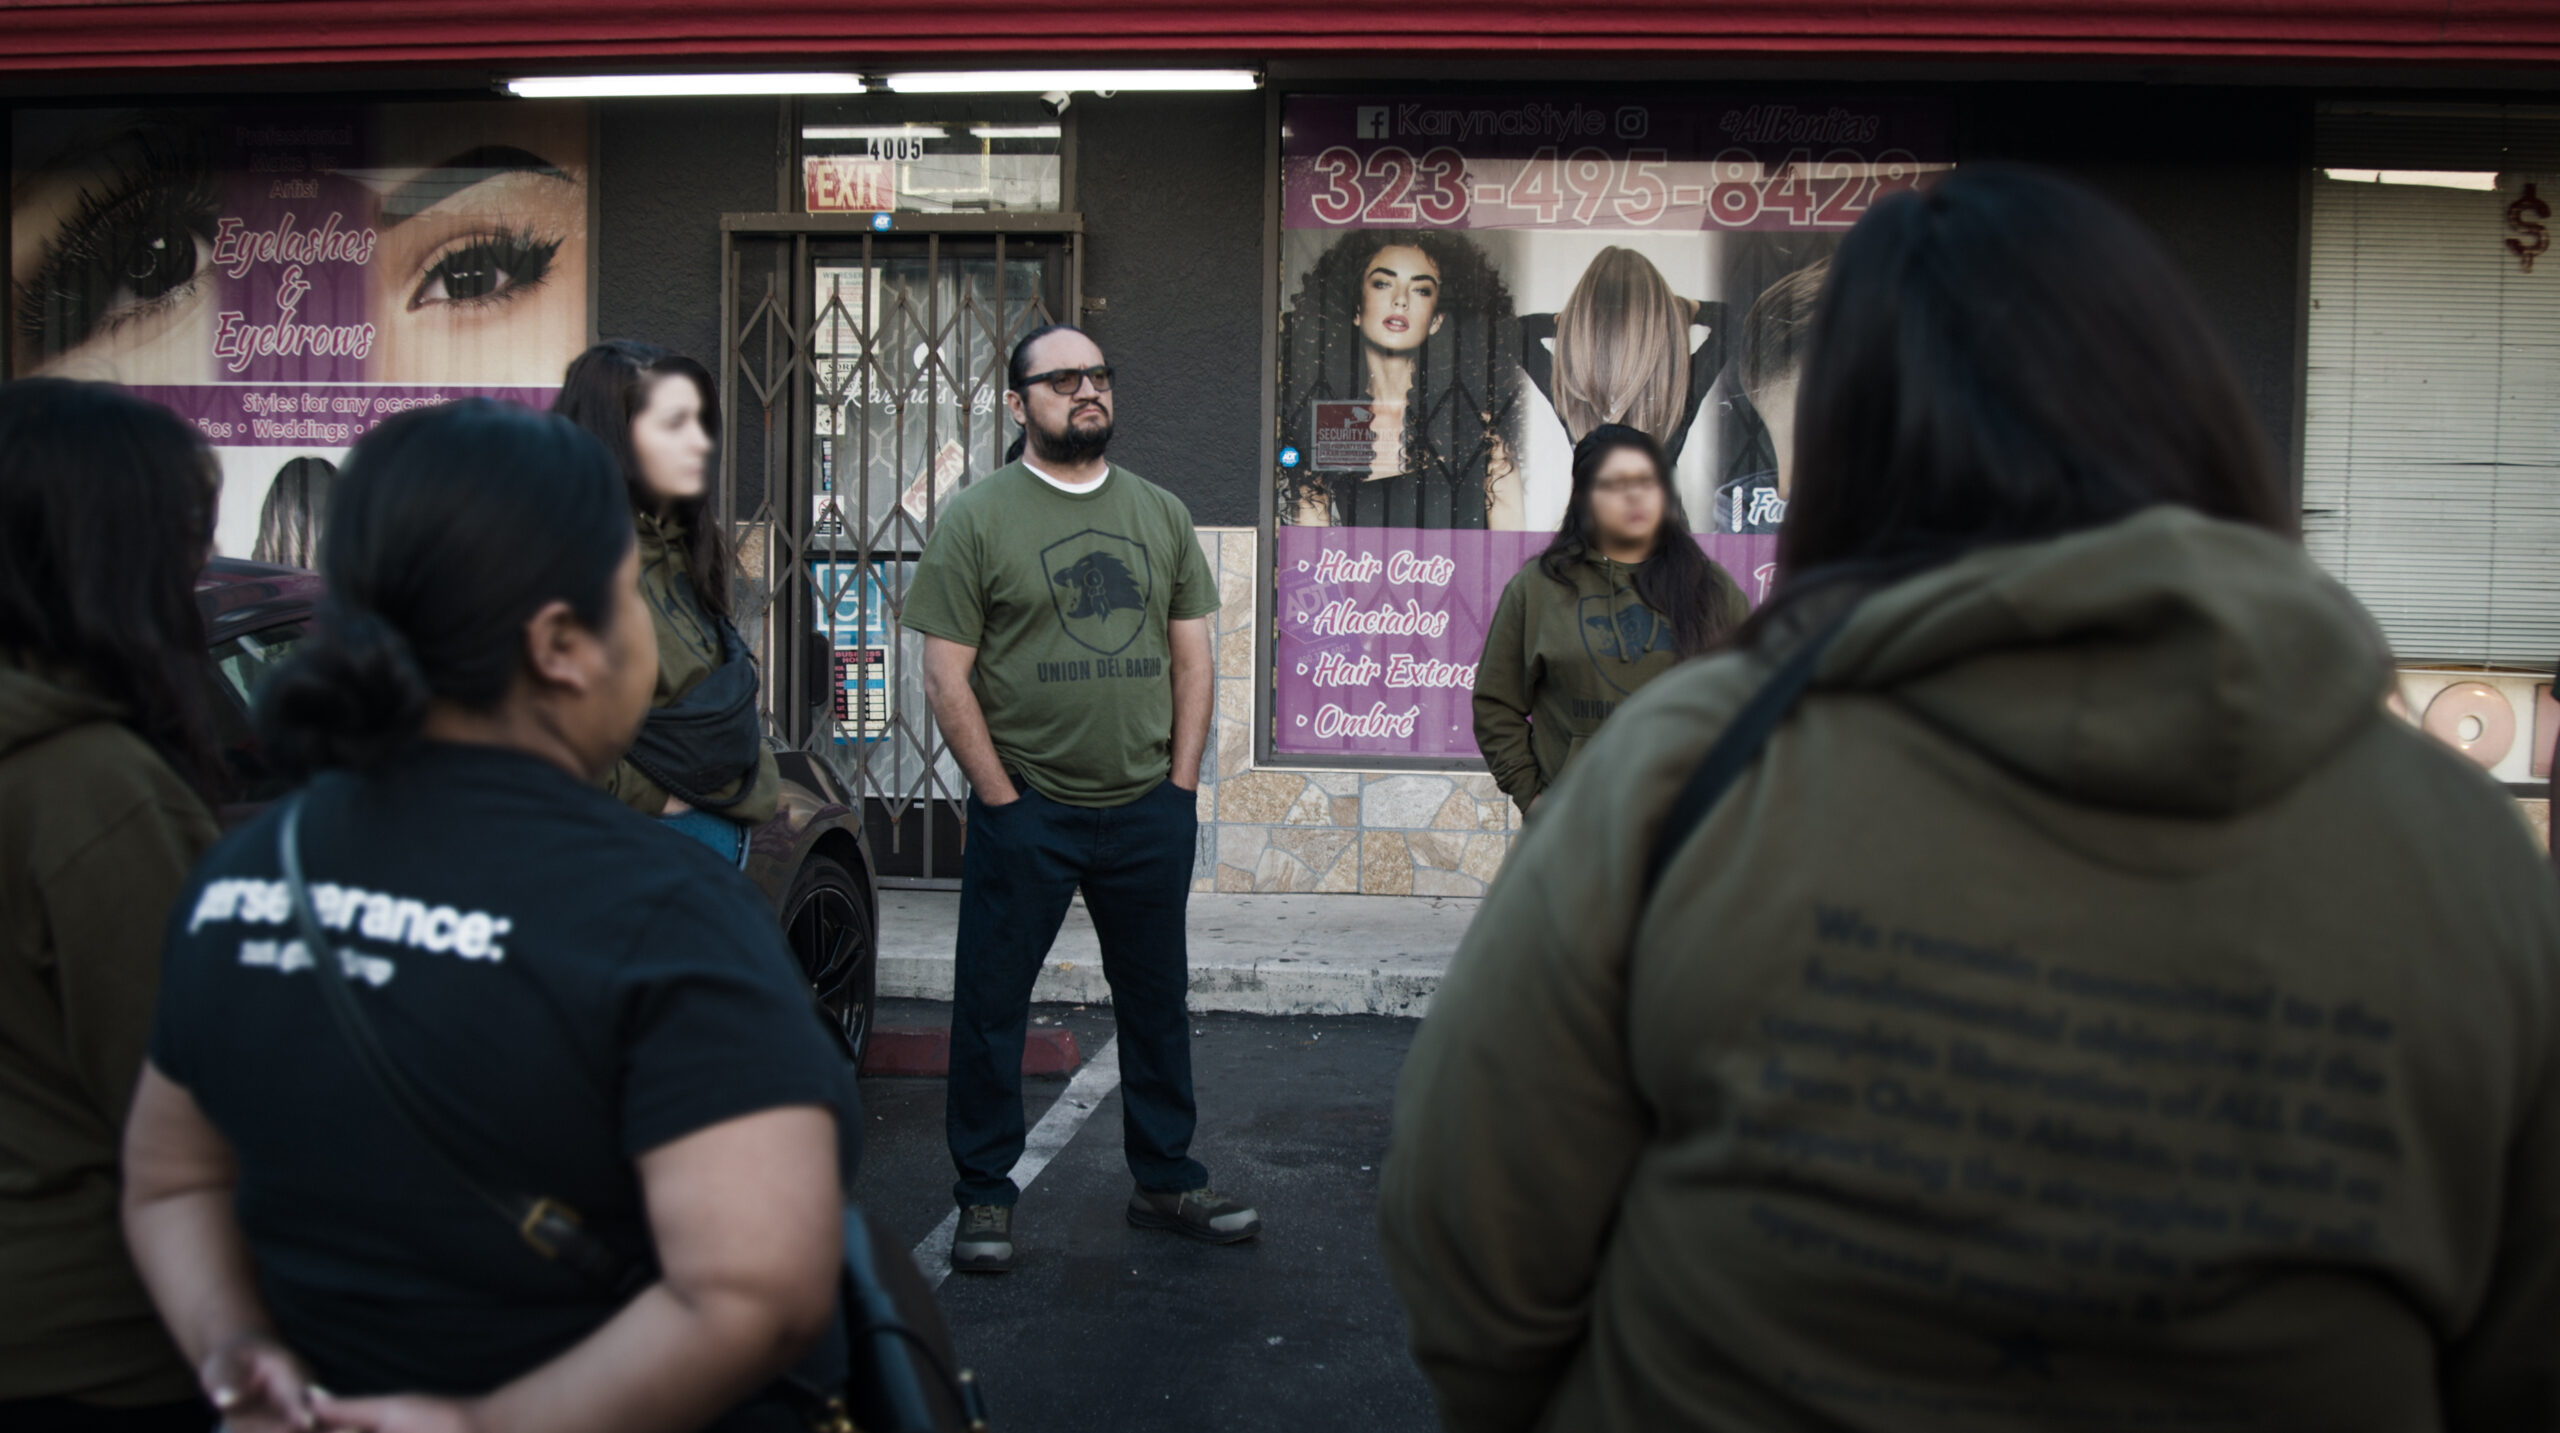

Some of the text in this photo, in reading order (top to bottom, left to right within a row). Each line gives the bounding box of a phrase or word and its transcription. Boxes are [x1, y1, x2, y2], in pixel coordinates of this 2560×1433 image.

[1398, 103, 1607, 142] KarynaStyle
[1719, 104, 1880, 143] #AllBonitas
[870, 138, 920, 160] 4005
[268, 178, 320, 200] Artist
[818, 164, 882, 207] EXIT
[212, 212, 377, 279] Eyelashes
[277, 264, 311, 311] &
[212, 308, 376, 372] Eyebrows
[242, 393, 298, 416] Styles
[301, 393, 328, 413] for
[332, 398, 370, 417] any
[189, 418, 232, 438] ños
[252, 418, 349, 442] Weddings
[1319, 428, 1363, 441] SECURITY
[1747, 487, 1786, 526] Fa
[1314, 548, 1455, 586] Hair Cuts
[1313, 597, 1449, 638] Alaciados
[1037, 661, 1091, 683] UNION
[1097, 658, 1123, 679] DEL
[1313, 652, 1381, 687] Hair
[1385, 654, 1479, 690] Extens
[1314, 701, 1420, 738] Ombré
